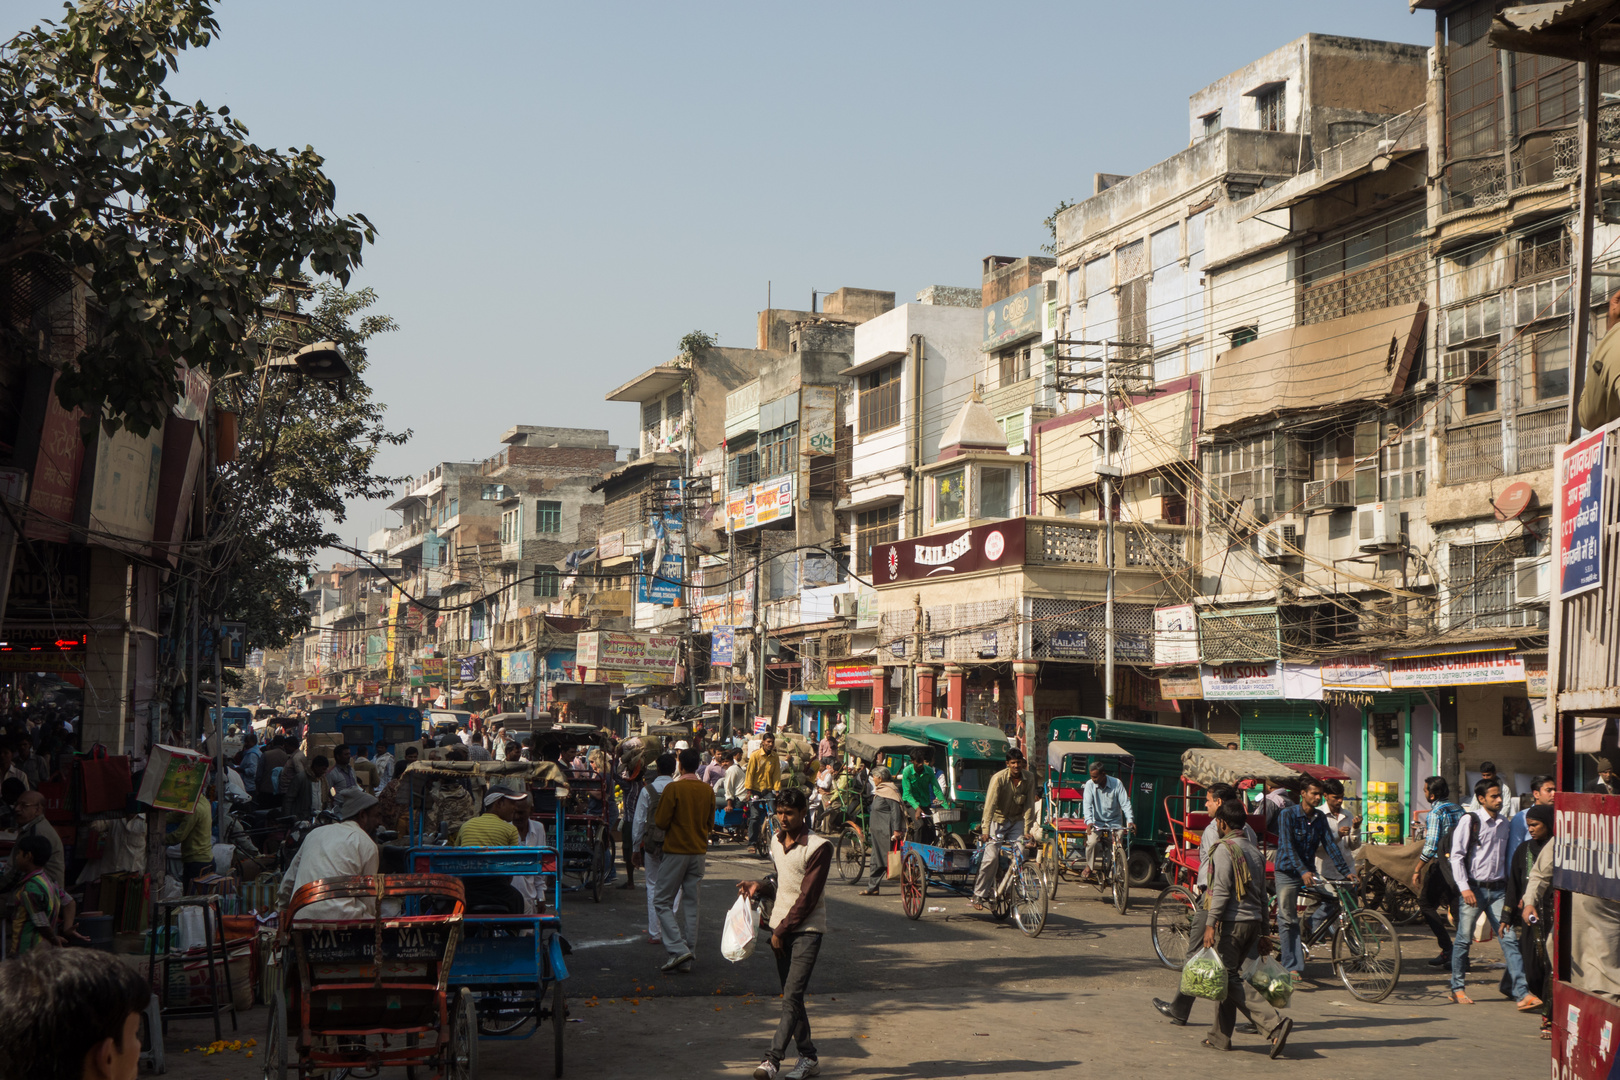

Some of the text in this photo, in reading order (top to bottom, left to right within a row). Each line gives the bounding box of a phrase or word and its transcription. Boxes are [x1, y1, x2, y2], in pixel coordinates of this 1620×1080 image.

[1569, 440, 1603, 479] सावधान
[1561, 516, 1577, 538] CCTV
[914, 531, 972, 566] KAILASH
[1561, 540, 1582, 569] निगरानी
[1051, 637, 1088, 648] KAILASH
[1236, 665, 1268, 679] SONS
[1391, 657, 1419, 673] AMAR
[1420, 655, 1445, 672] DASS
[1446, 651, 1495, 671] CHAMAN
[1495, 650, 1521, 668] LAL
[306, 679, 319, 690] 15
[1442, 671, 1472, 680] DISTRIBUTOR
[1473, 670, 1488, 678] HEINZ
[1490, 669, 1505, 677] INDIA
[1554, 809, 1589, 874] DELHI
